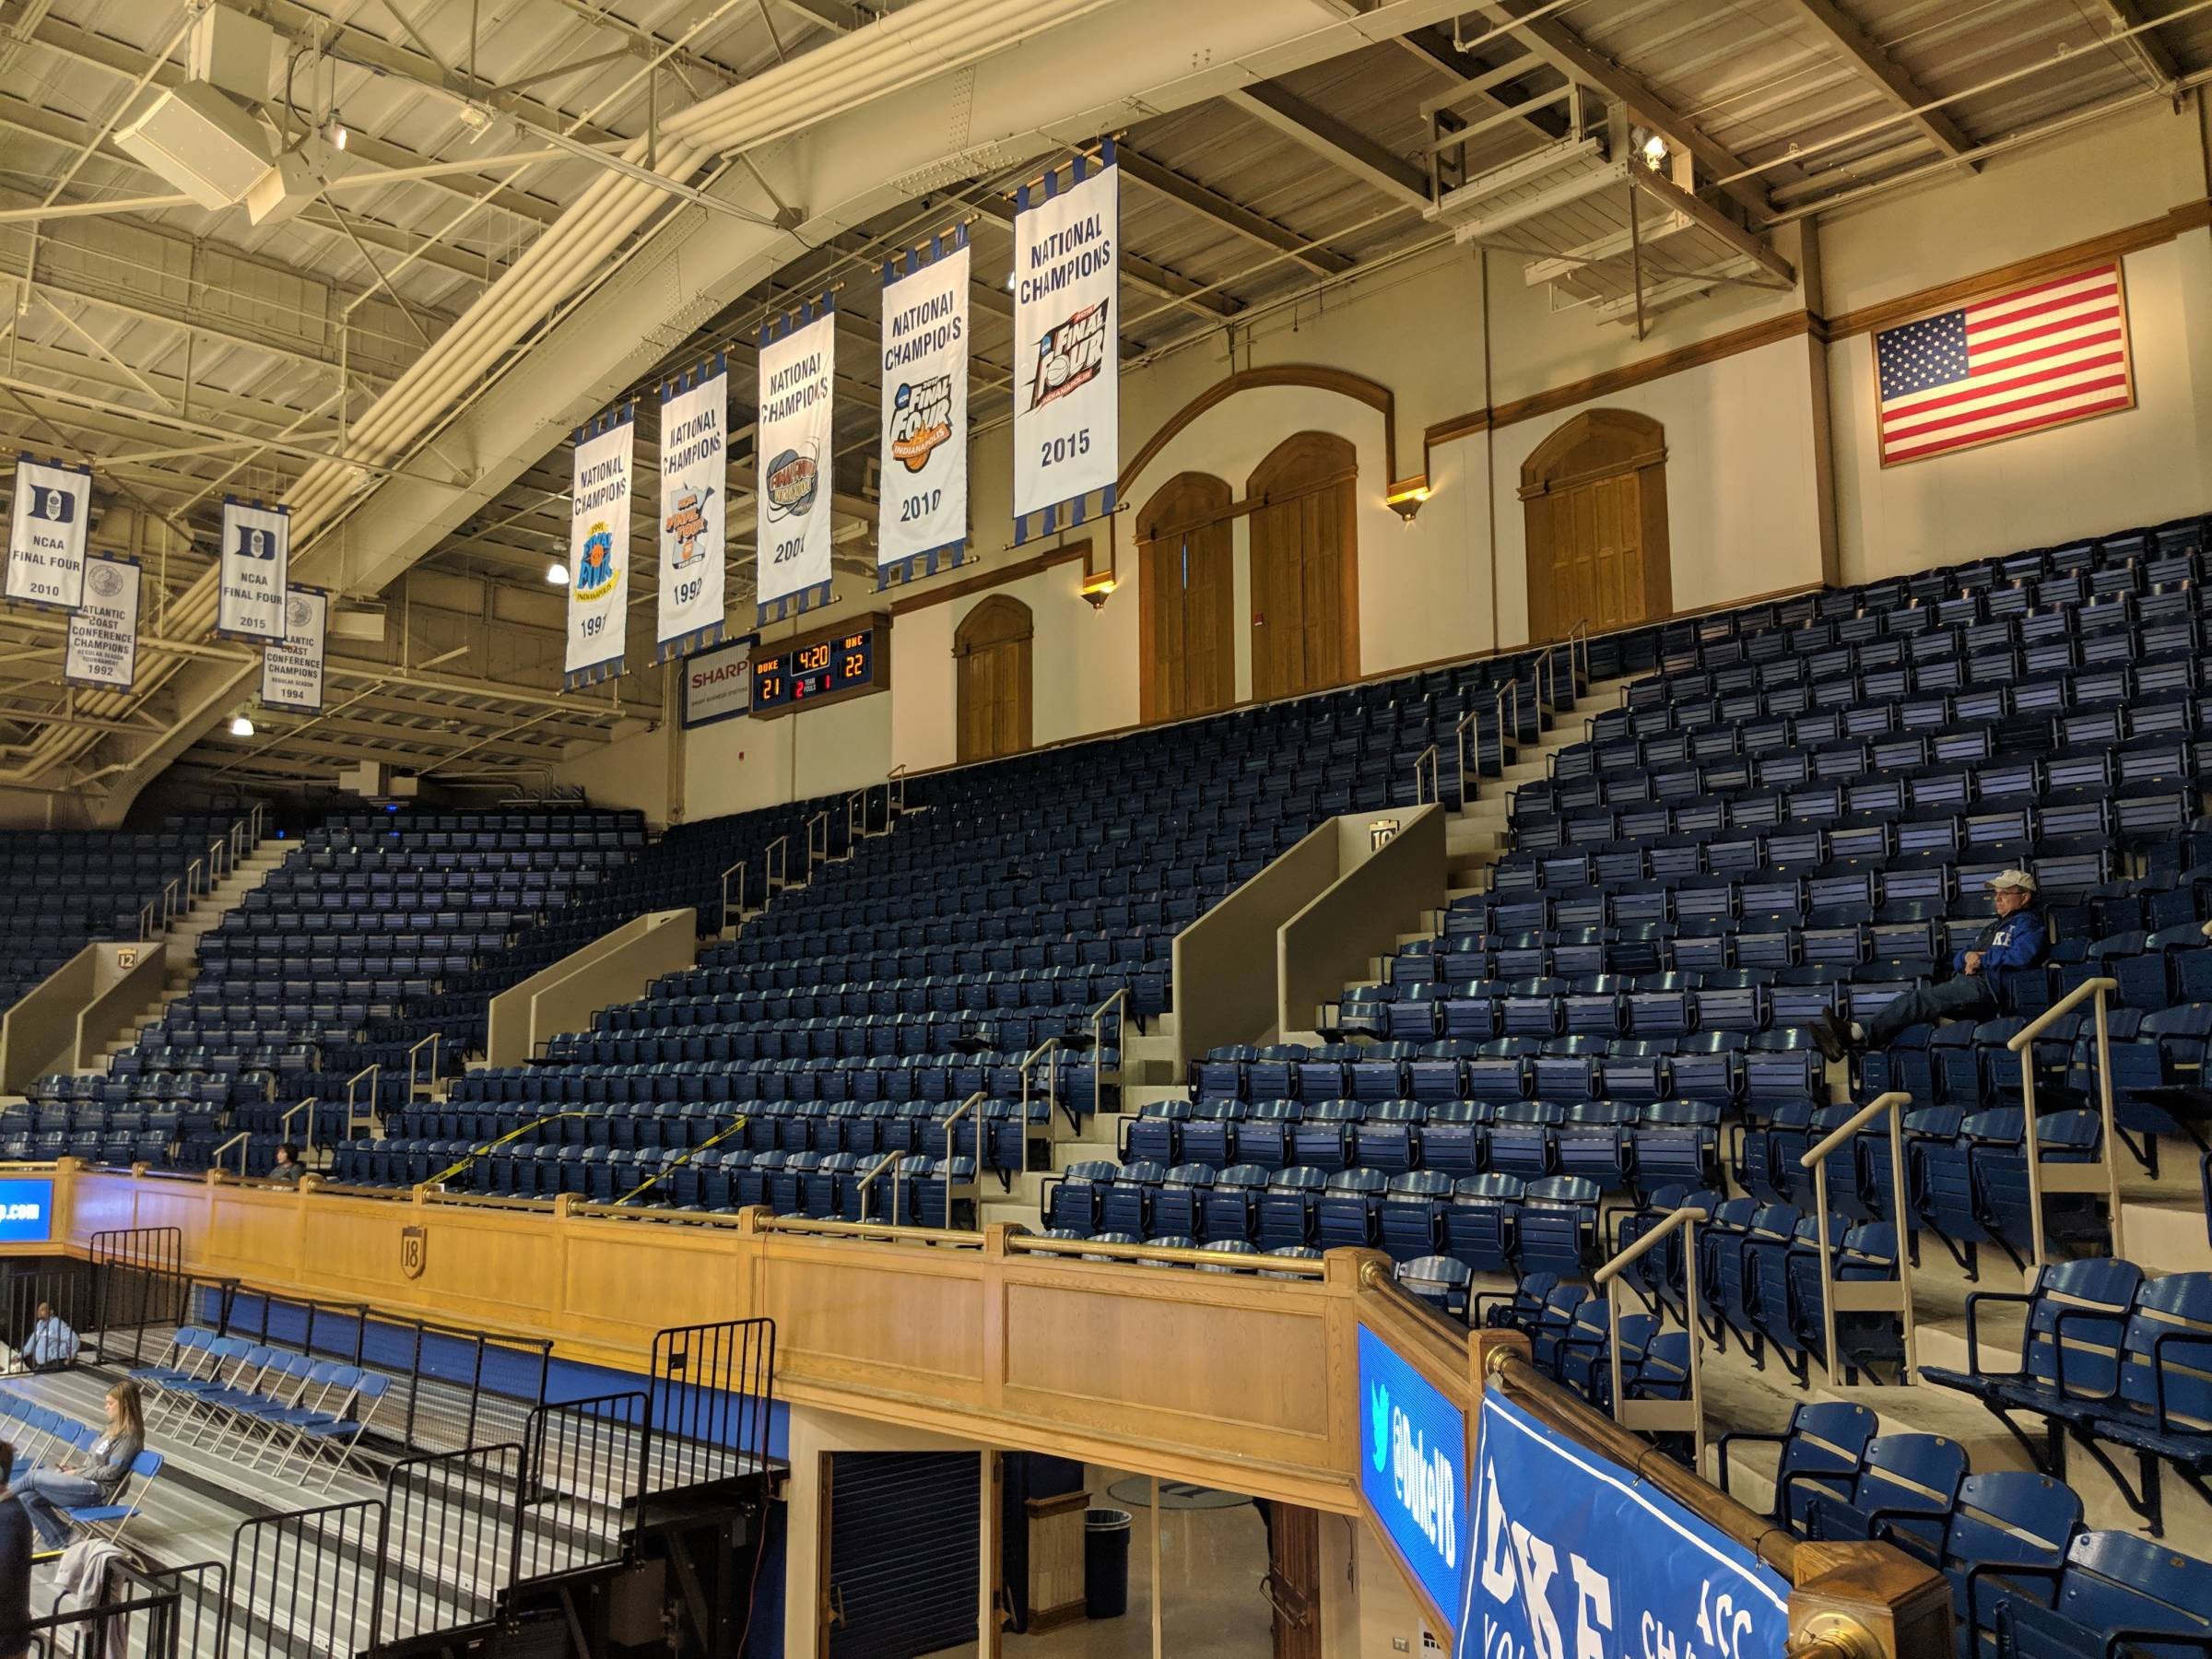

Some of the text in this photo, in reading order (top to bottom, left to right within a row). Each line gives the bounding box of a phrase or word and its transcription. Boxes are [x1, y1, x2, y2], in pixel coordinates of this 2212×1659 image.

[1030, 213, 1102, 270] NATIONAL
[1020, 239, 1111, 305] CHAMPIONS
[892, 289, 954, 338] NATIONAL
[885, 315, 962, 371] CHAMPIONS
[770, 352, 820, 396] NATIONAL
[760, 376, 829, 425] CHAMPIONS
[909, 377, 950, 414] FINAL
[670, 408, 717, 450] NATIONAL
[890, 397, 950, 441] FOUR
[664, 430, 722, 477] CHAMPIONS
[894, 428, 945, 455] INDIANAPOLIS
[1041, 428, 1091, 468] 2015
[581, 454, 624, 489] NATIONAL
[574, 477, 627, 516] CHAMPIONS
[900, 488, 942, 524] 2010
[33, 535, 65, 550] NCAA
[774, 536, 806, 565] 2001
[13, 550, 80, 572] FINAL FOUR
[29, 582, 60, 597] 2010
[241, 571, 269, 586] NCAA
[224, 585, 283, 606] FINAL FOUR
[674, 578, 703, 606] 1992
[83, 606, 126, 620] ATLANTIC
[89, 618, 119, 630] COAST
[240, 616, 266, 629] 2015
[72, 626, 133, 643] CONFERENCE
[74, 638, 130, 655] CHAMPIONS
[285, 635, 314, 647] LANTIC
[845, 635, 863, 649] UNC
[88, 664, 113, 677] 1992
[266, 653, 321, 670] CONFERENCE
[268, 665, 318, 679] CHAMPIONS
[758, 645, 829, 675] DUKE 4:20
[845, 653, 864, 677] 22
[692, 660, 748, 688] SHARP
[280, 688, 304, 700] 1994
[763, 677, 780, 700] 21
[795, 679, 804, 699] 2
[120, 954, 134, 967] 12
[405, 1240, 418, 1268] 18
